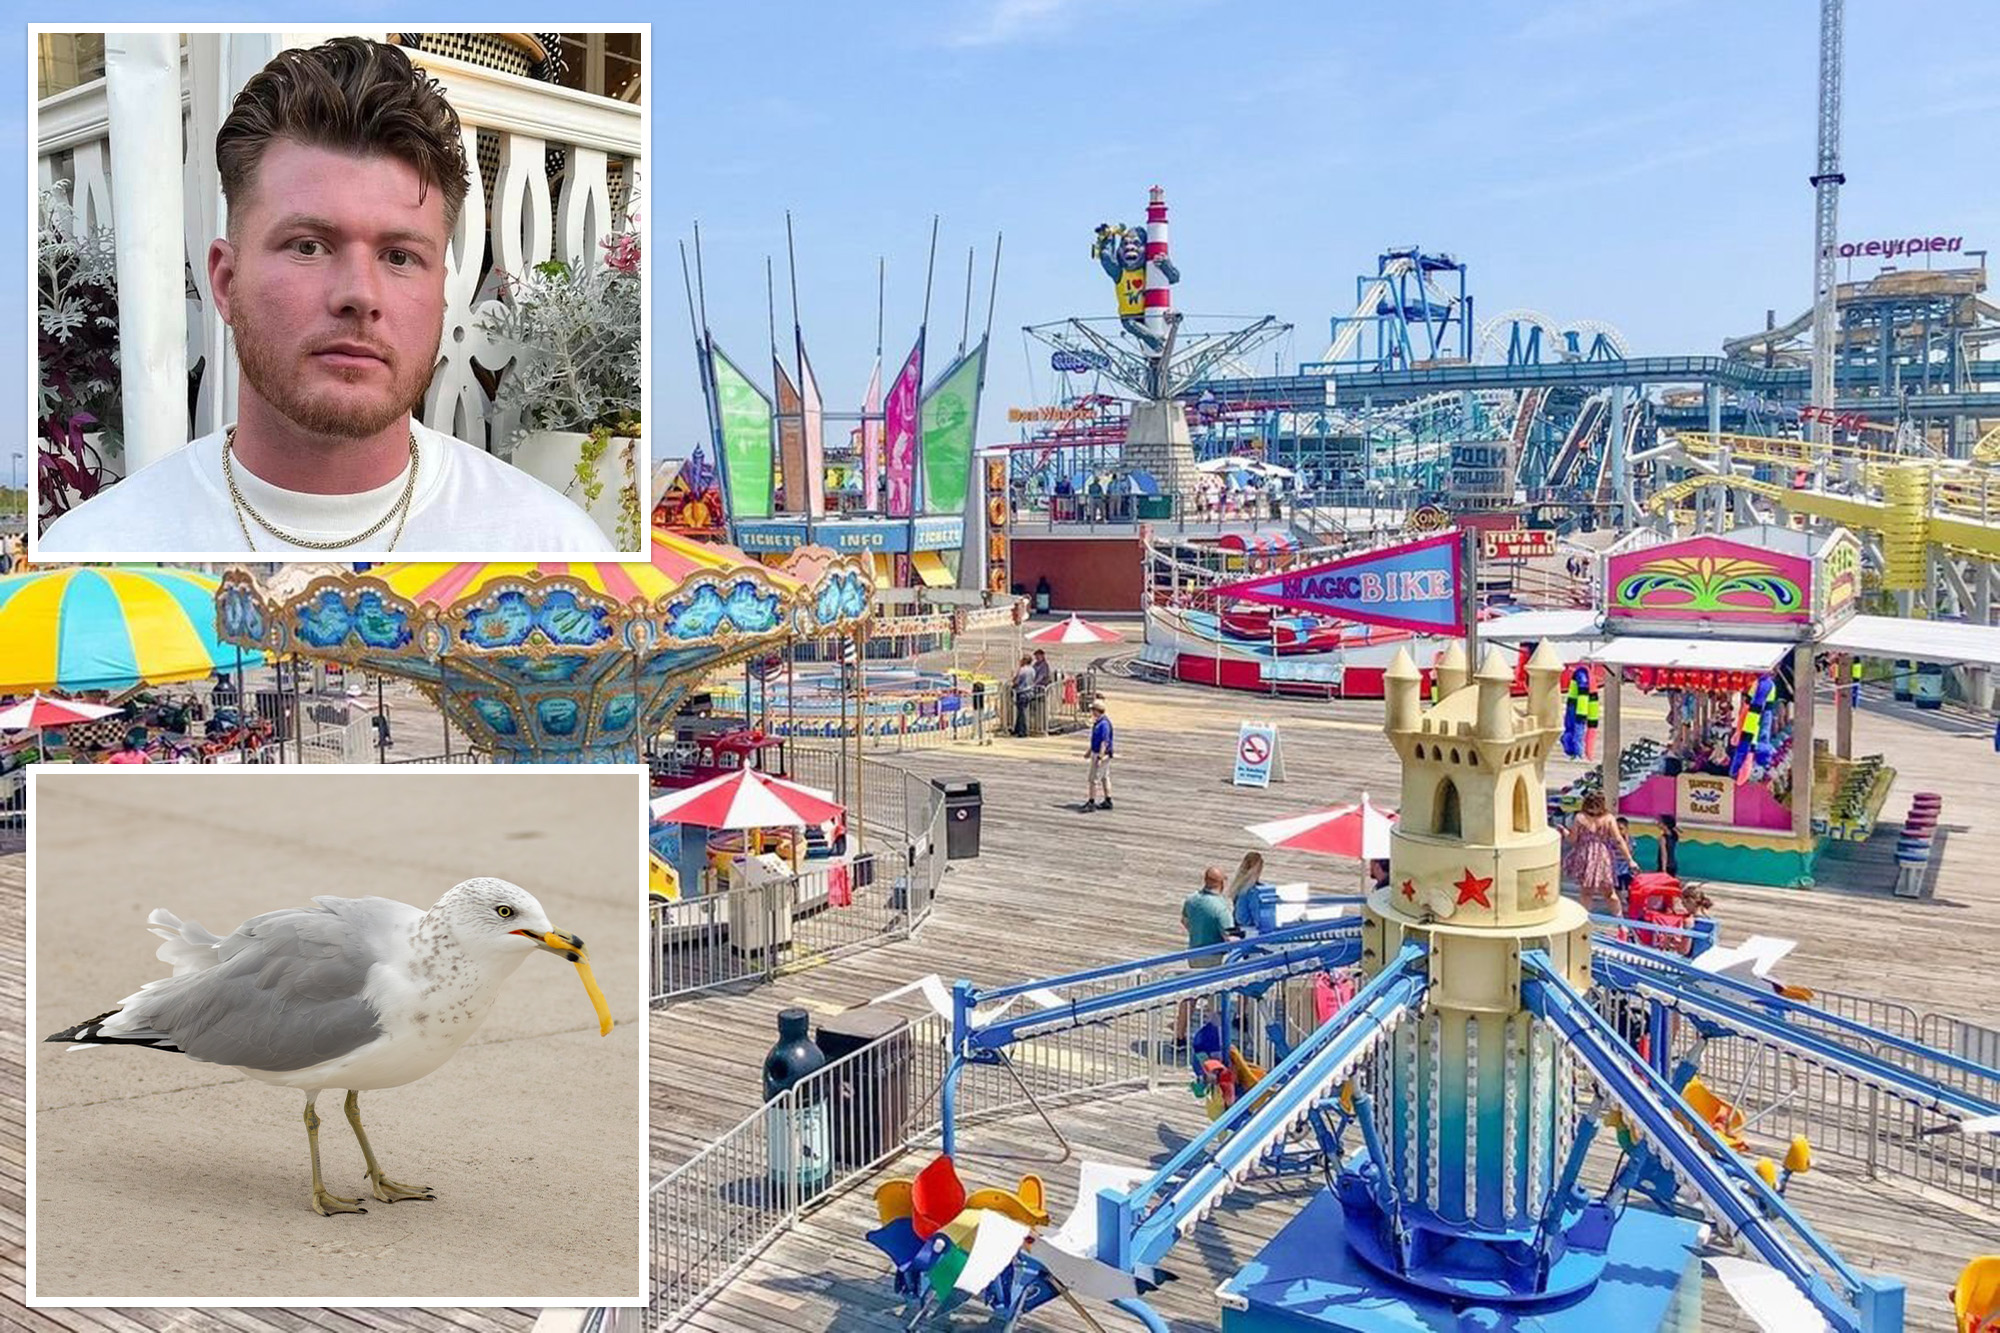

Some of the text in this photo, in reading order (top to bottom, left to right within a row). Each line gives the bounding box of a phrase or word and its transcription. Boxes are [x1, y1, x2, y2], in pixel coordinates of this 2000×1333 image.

[741, 532, 801, 547] TICKETS
[840, 534, 883, 546] INFO
[1508, 544, 1554, 556] WHIRL
[1281, 570, 1454, 603] MAGIC BIKE
